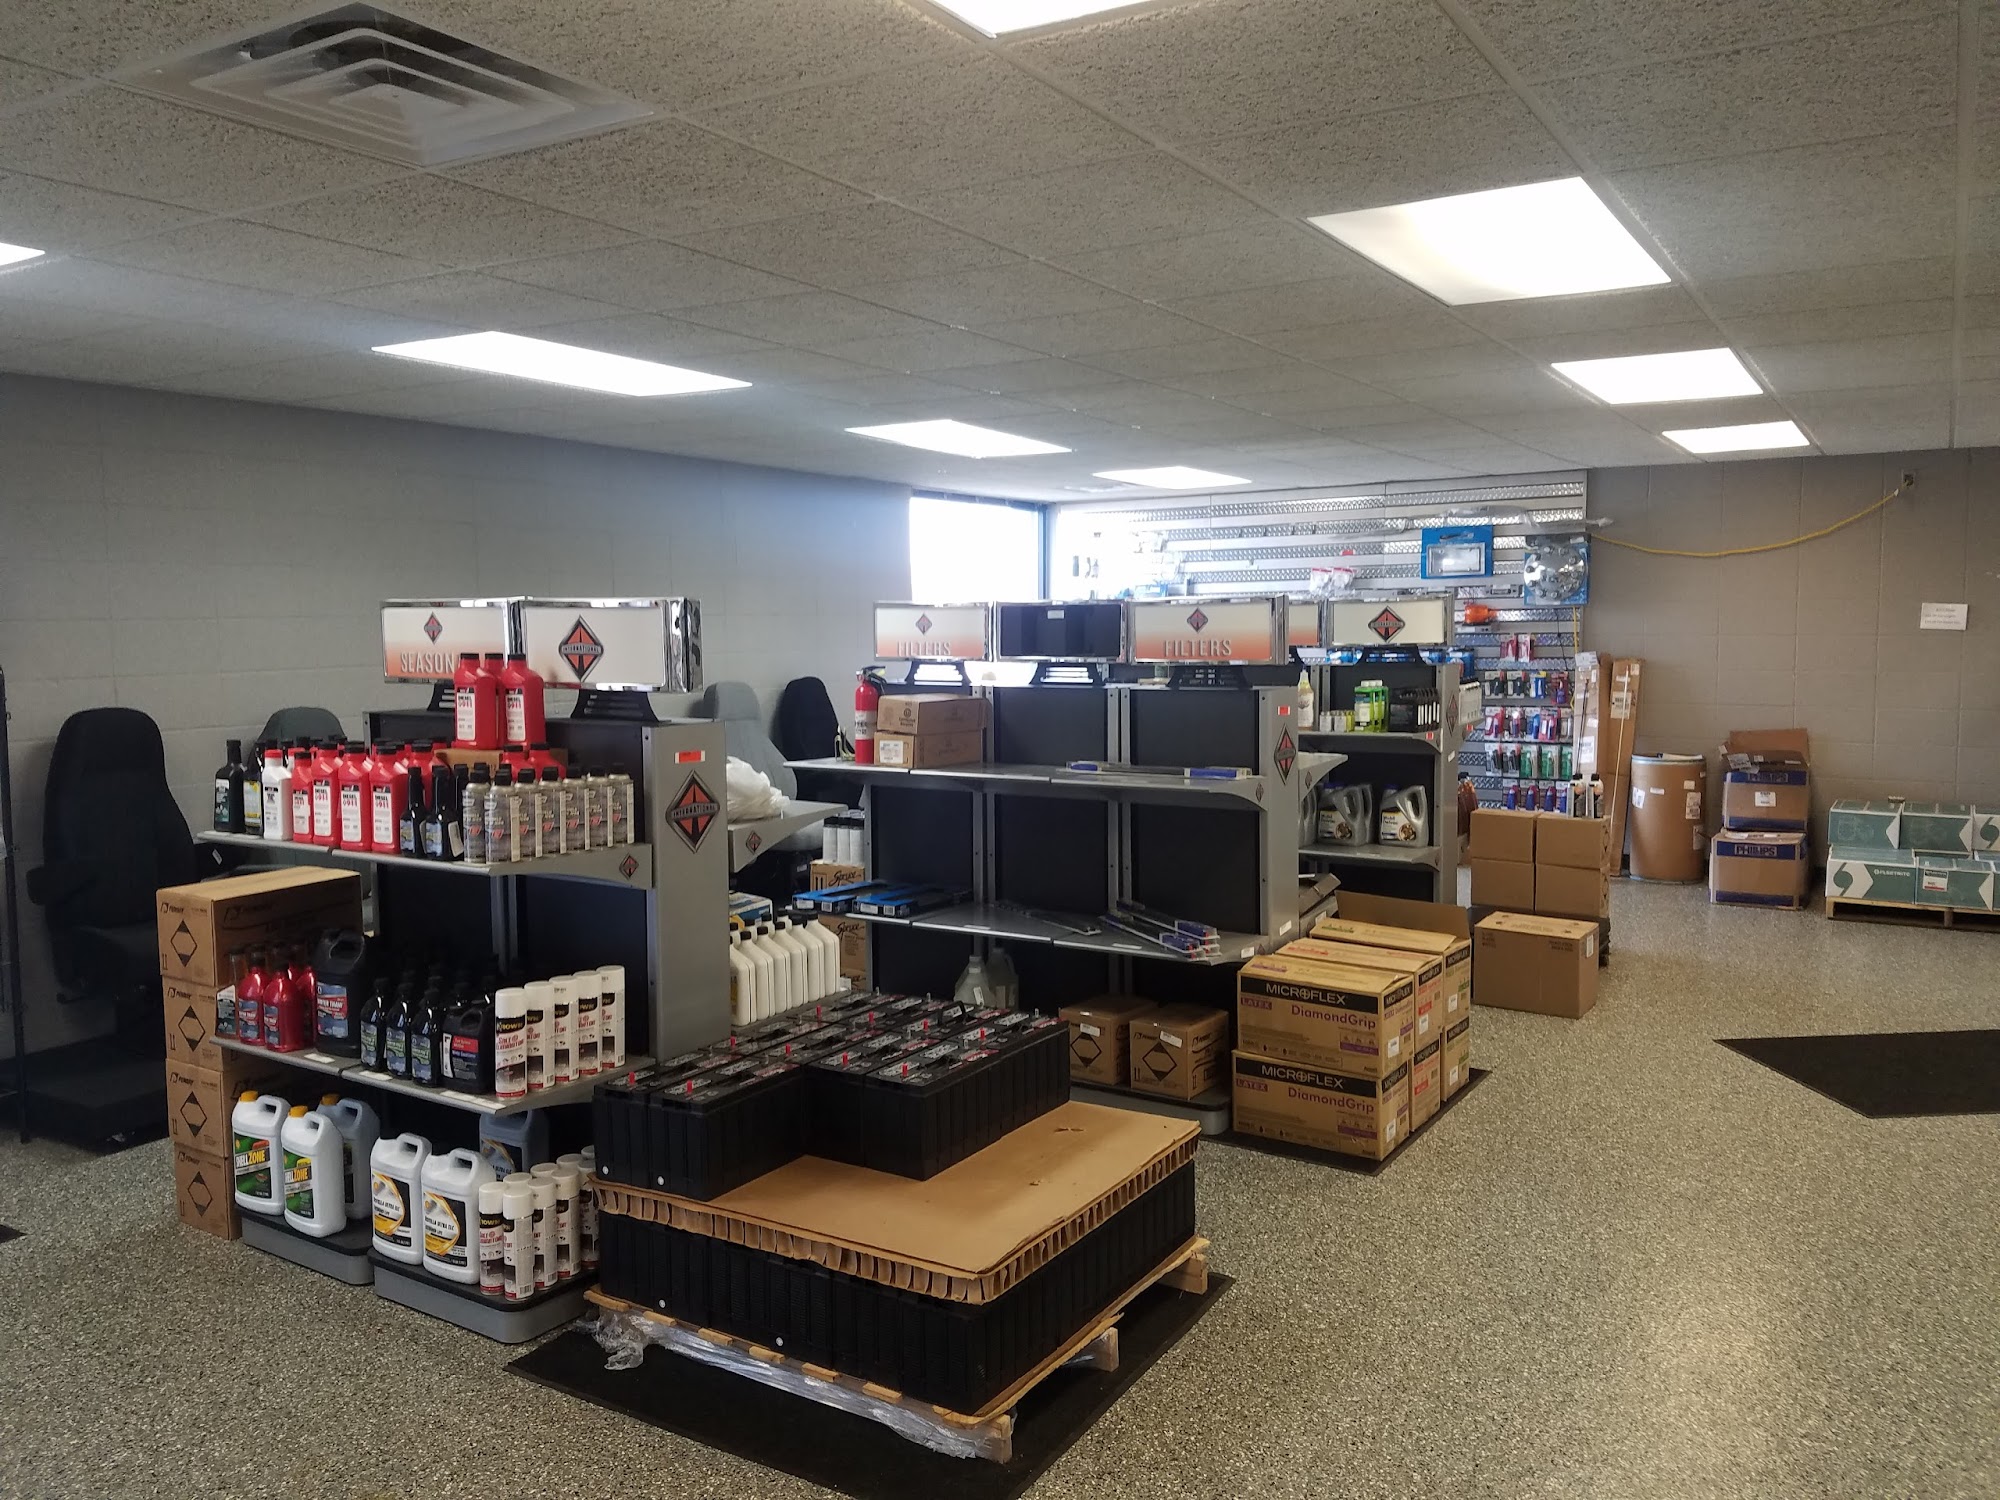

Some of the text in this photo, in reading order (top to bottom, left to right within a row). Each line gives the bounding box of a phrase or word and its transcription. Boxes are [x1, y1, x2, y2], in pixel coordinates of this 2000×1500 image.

[897, 641, 952, 656] FILTERS
[1164, 639, 1232, 657] FILTERS
[400, 652, 461, 674] SEASON
[1734, 843, 1778, 857] PHILIPS
[1241, 997, 1271, 1010] LATEX
[1266, 983, 1346, 1006] MICROFLEX
[1291, 1004, 1376, 1030] DiamondGrip
[1236, 1079, 1267, 1092] LATEX
[1261, 1064, 1344, 1089] MICROFLEX
[1288, 1087, 1375, 1115] DiamondGrip
